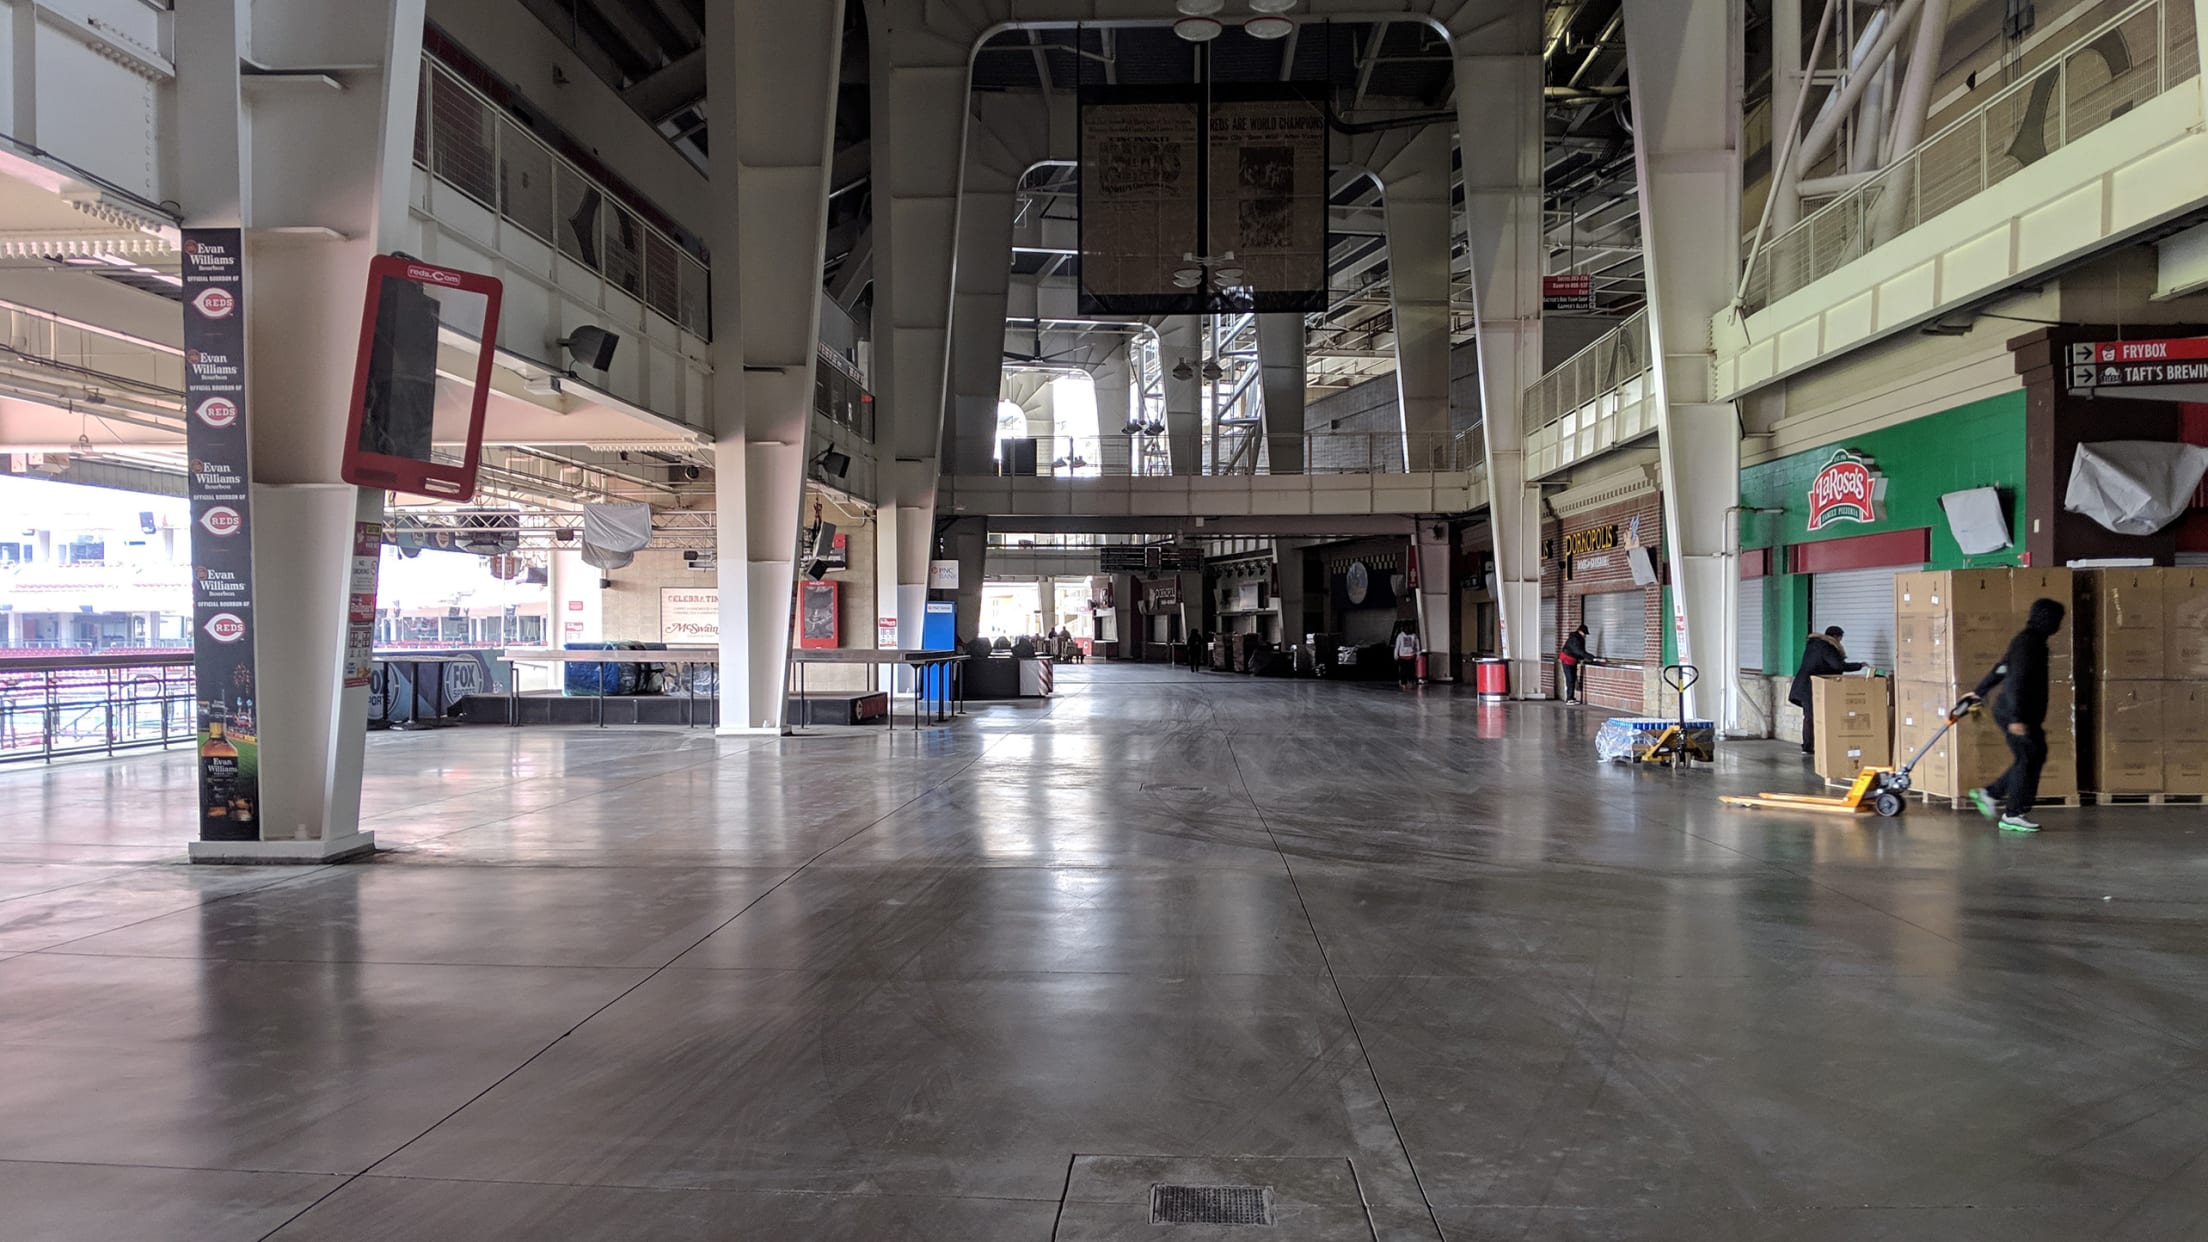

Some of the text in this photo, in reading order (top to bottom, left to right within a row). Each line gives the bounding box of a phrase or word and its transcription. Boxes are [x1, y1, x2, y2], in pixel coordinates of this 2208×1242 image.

[1210, 118, 1229, 131] REDS
[1232, 117, 1248, 131] ARE
[1250, 117, 1277, 130] WORLD
[1279, 116, 1324, 130] CHAMPIONS
[198, 243, 225, 254] Evan
[190, 254, 235, 265] Williams
[205, 298, 233, 307] REDS
[2123, 343, 2167, 358] FRYBOX
[200, 352, 228, 363] Evan
[192, 363, 238, 374] Williams
[2125, 365, 2163, 382] TAFT'S
[2167, 364, 2208, 380] BREWIN
[207, 407, 236, 416] REDS
[203, 462, 231, 472] Evan
[195, 473, 241, 483] Williams
[1822, 508, 1837, 520] FAMILY
[211, 517, 239, 525] REDS
[1565, 525, 1613, 580] PORKOPOLIS
[207, 569, 235, 579] Evan
[200, 580, 245, 591] Williams
[668, 595, 719, 603] CELEBRATIN
[216, 623, 244, 632] REDS
[453, 664, 476, 688] FOX
[213, 757, 233, 765] Evan
[208, 765, 237, 773] Williams
